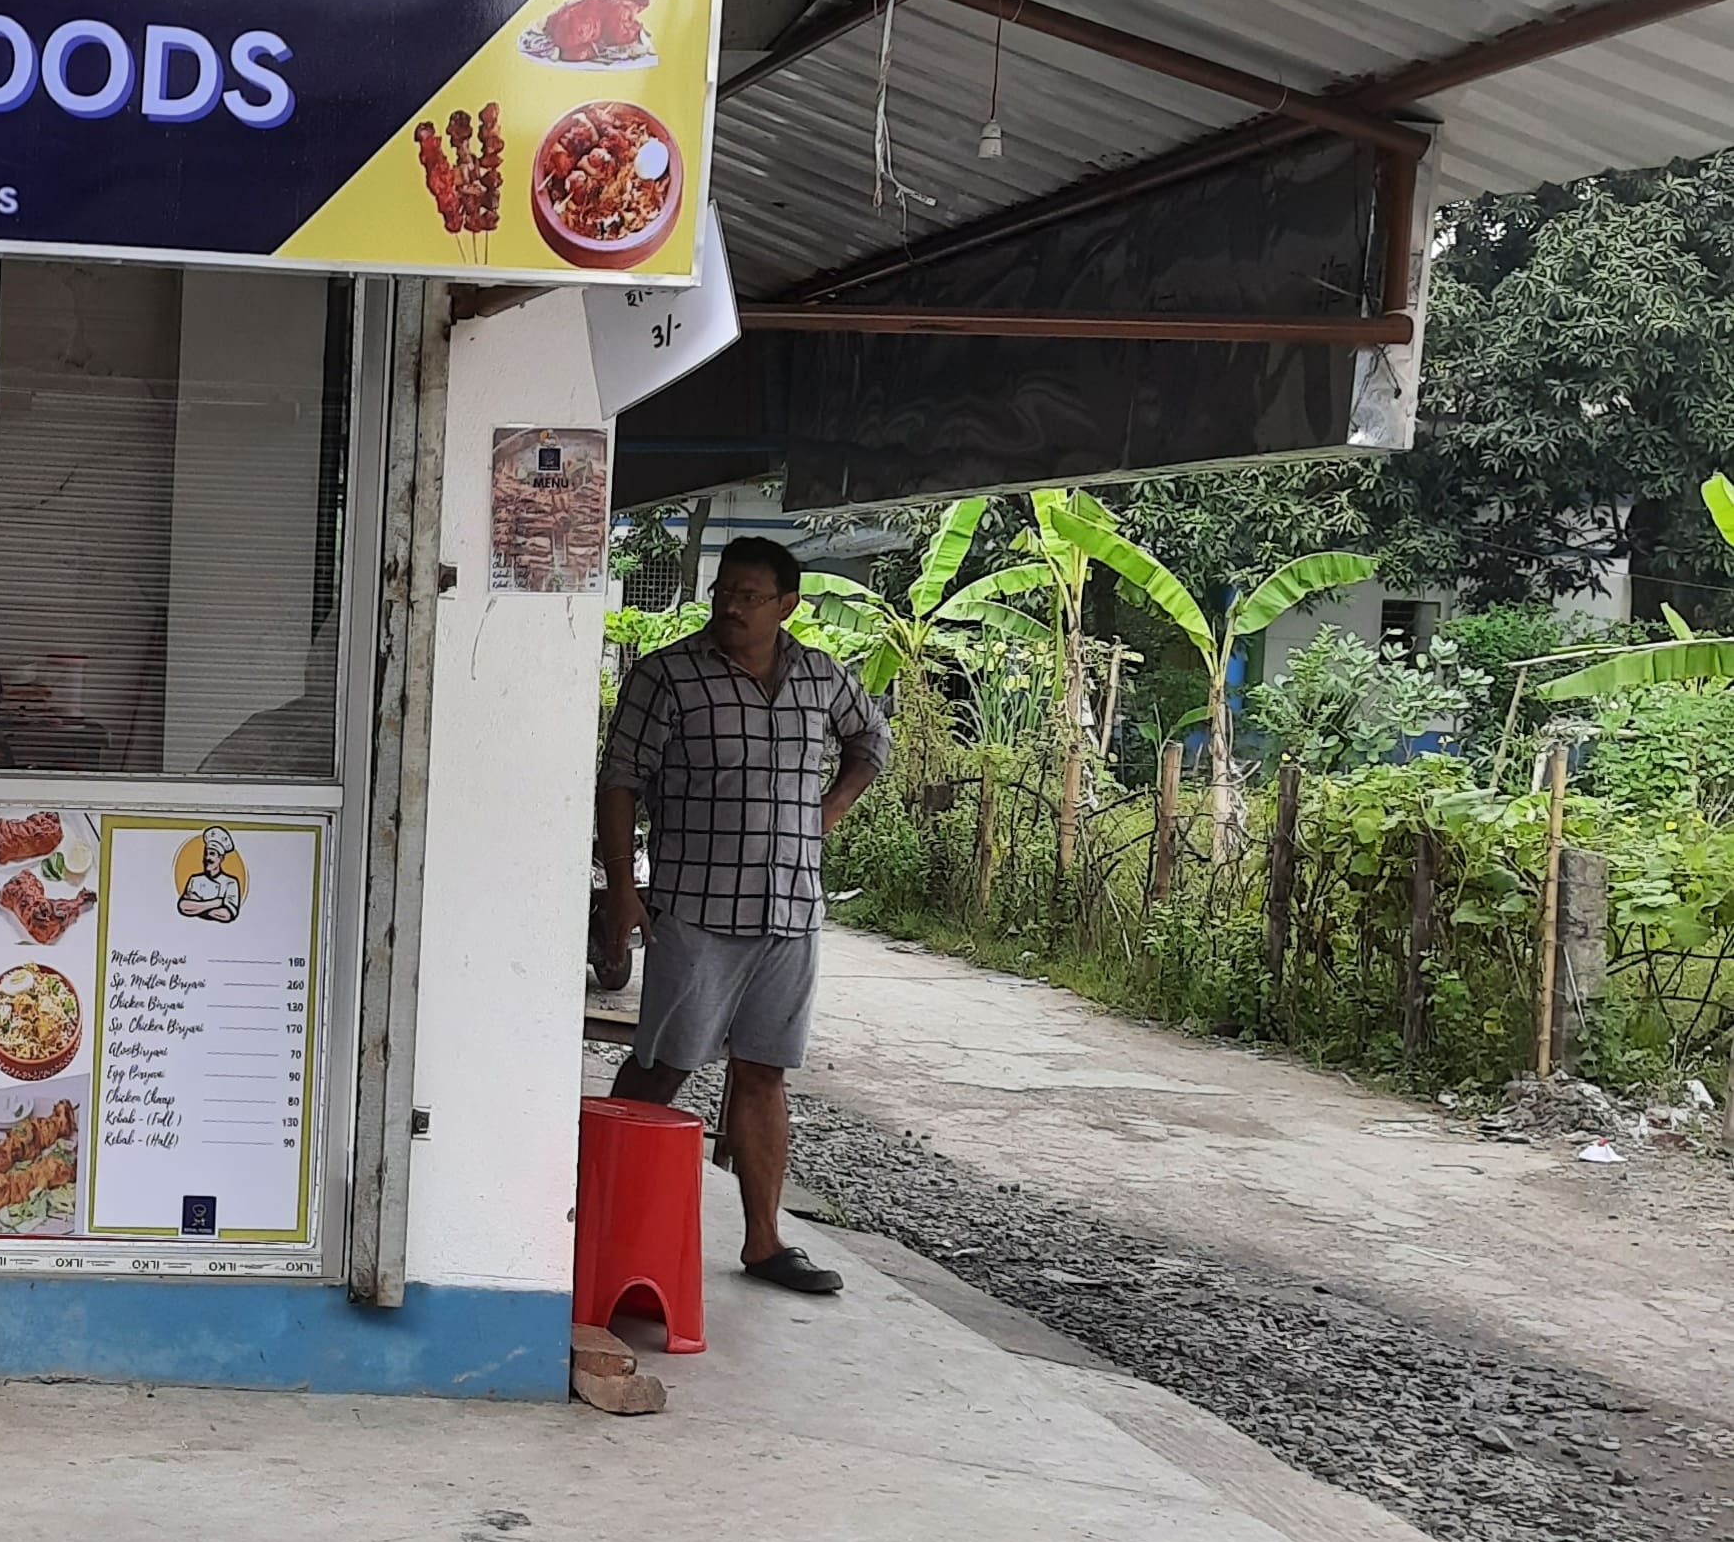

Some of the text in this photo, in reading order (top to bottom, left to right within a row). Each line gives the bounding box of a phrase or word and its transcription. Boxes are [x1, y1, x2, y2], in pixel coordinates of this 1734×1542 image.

[651, 313, 682, 349] 3/-
[533, 477, 569, 489] MENU
[111, 949, 148, 967] Mutton
[150, 950, 187, 972] Biryani
[130, 973, 167, 990] Mutton
[169, 973, 207, 995] Biryani
[109, 990, 145, 1010] Chicken
[147, 995, 185, 1016] Biryani
[128, 1014, 164, 1034] Chicken
[166, 1018, 204, 1040] Biryani
[286, 1024, 303, 1034] 170
[290, 1049, 302, 1059] 70
[107, 1064, 125, 1084] Egg
[289, 1072, 301, 1081] 90
[106, 1086, 141, 1105] Chicken
[288, 1097, 300, 1106] 80
[282, 1117, 298, 1127] 130
[104, 1126, 135, 1146] Kebab
[283, 1139, 295, 1148] 90
[55, 1257, 84, 1269] ILKO
[132, 1259, 160, 1271] ILKO
[208, 1260, 237, 1272] ILKO
[285, 1261, 314, 1273] ILKO
